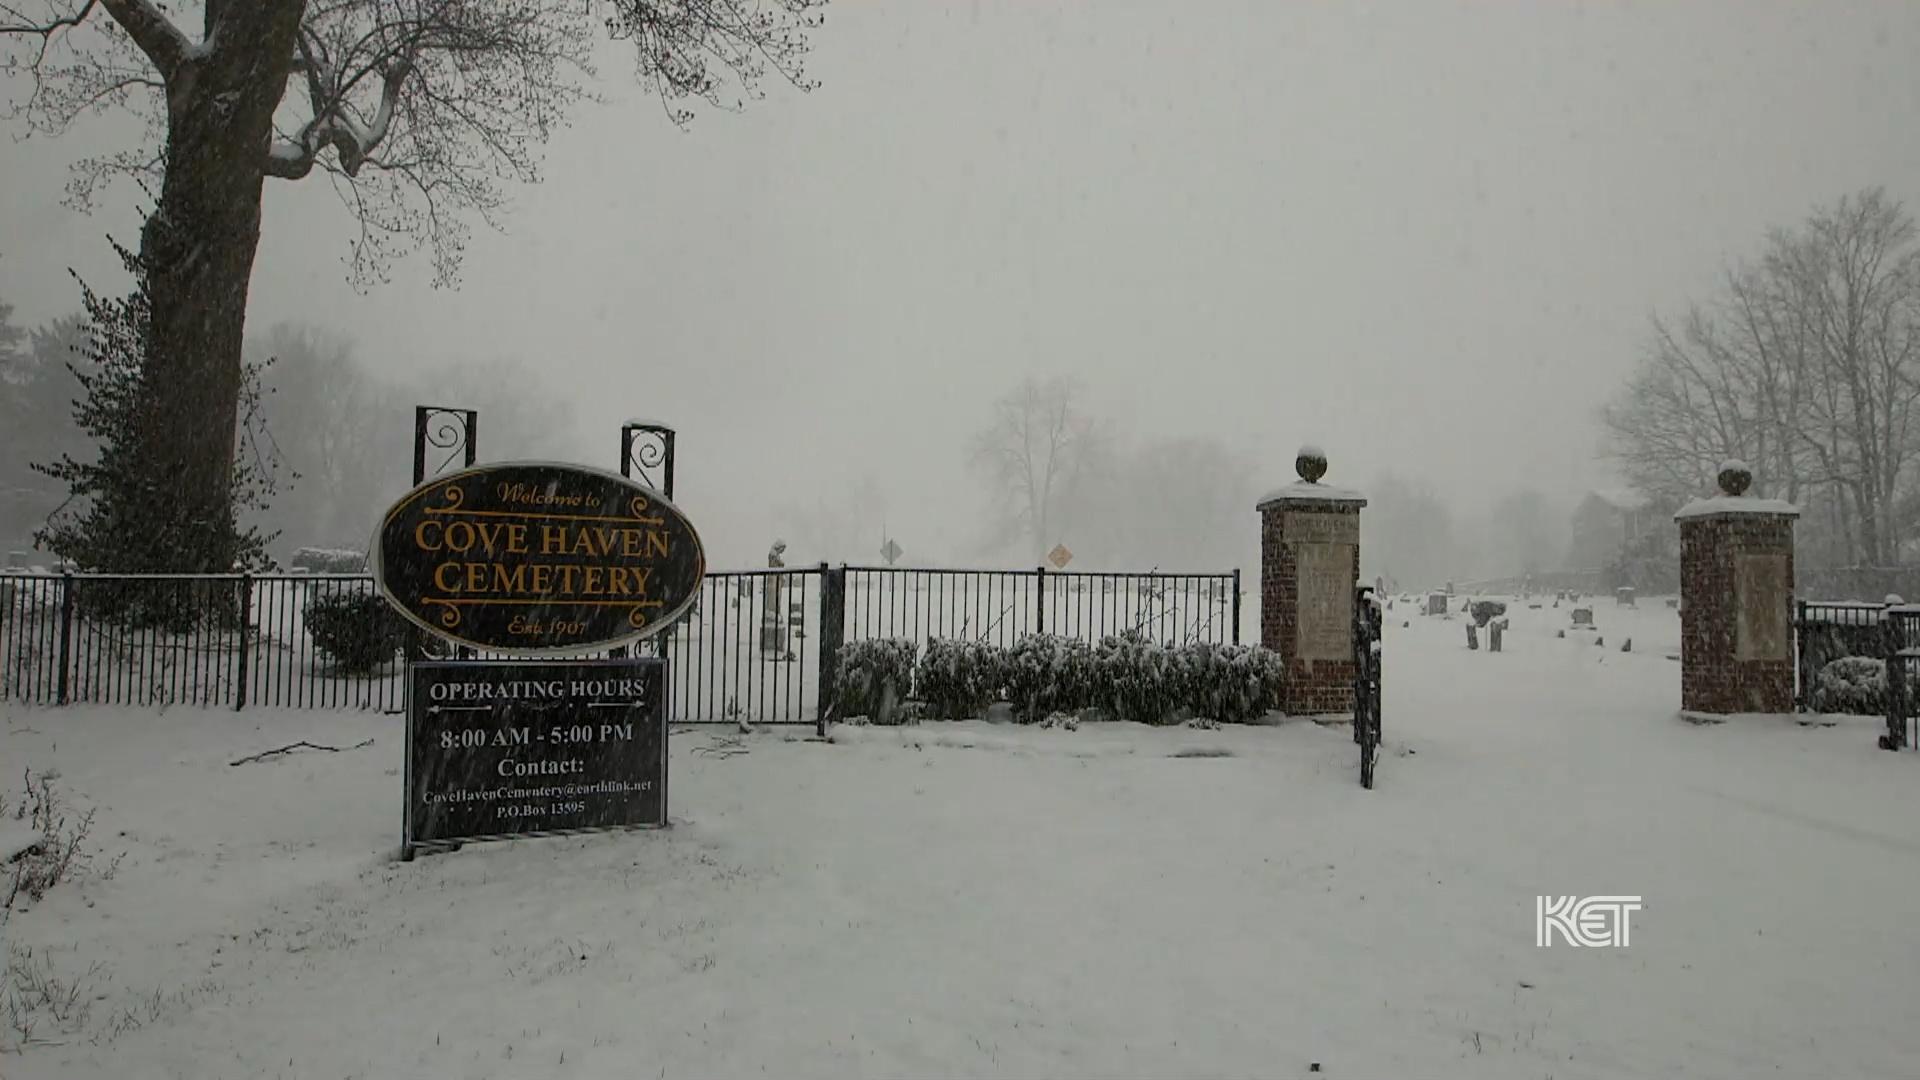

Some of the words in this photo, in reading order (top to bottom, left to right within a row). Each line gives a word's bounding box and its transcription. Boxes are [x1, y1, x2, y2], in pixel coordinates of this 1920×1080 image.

[497, 481, 582, 506] Welcome
[585, 490, 601, 508] to
[415, 520, 528, 554] COVE
[540, 527, 670, 558] HAVEN
[434, 561, 655, 595] CEMETERY
[548, 618, 587, 636] 1907
[430, 680, 564, 701] OPERATING
[571, 679, 645, 697] HOURS
[440, 729, 486, 749] 8:00
[491, 727, 529, 746] AM
[551, 725, 593, 744] 5:00
[599, 723, 633, 742] PM
[497, 757, 585, 777] Contact:
